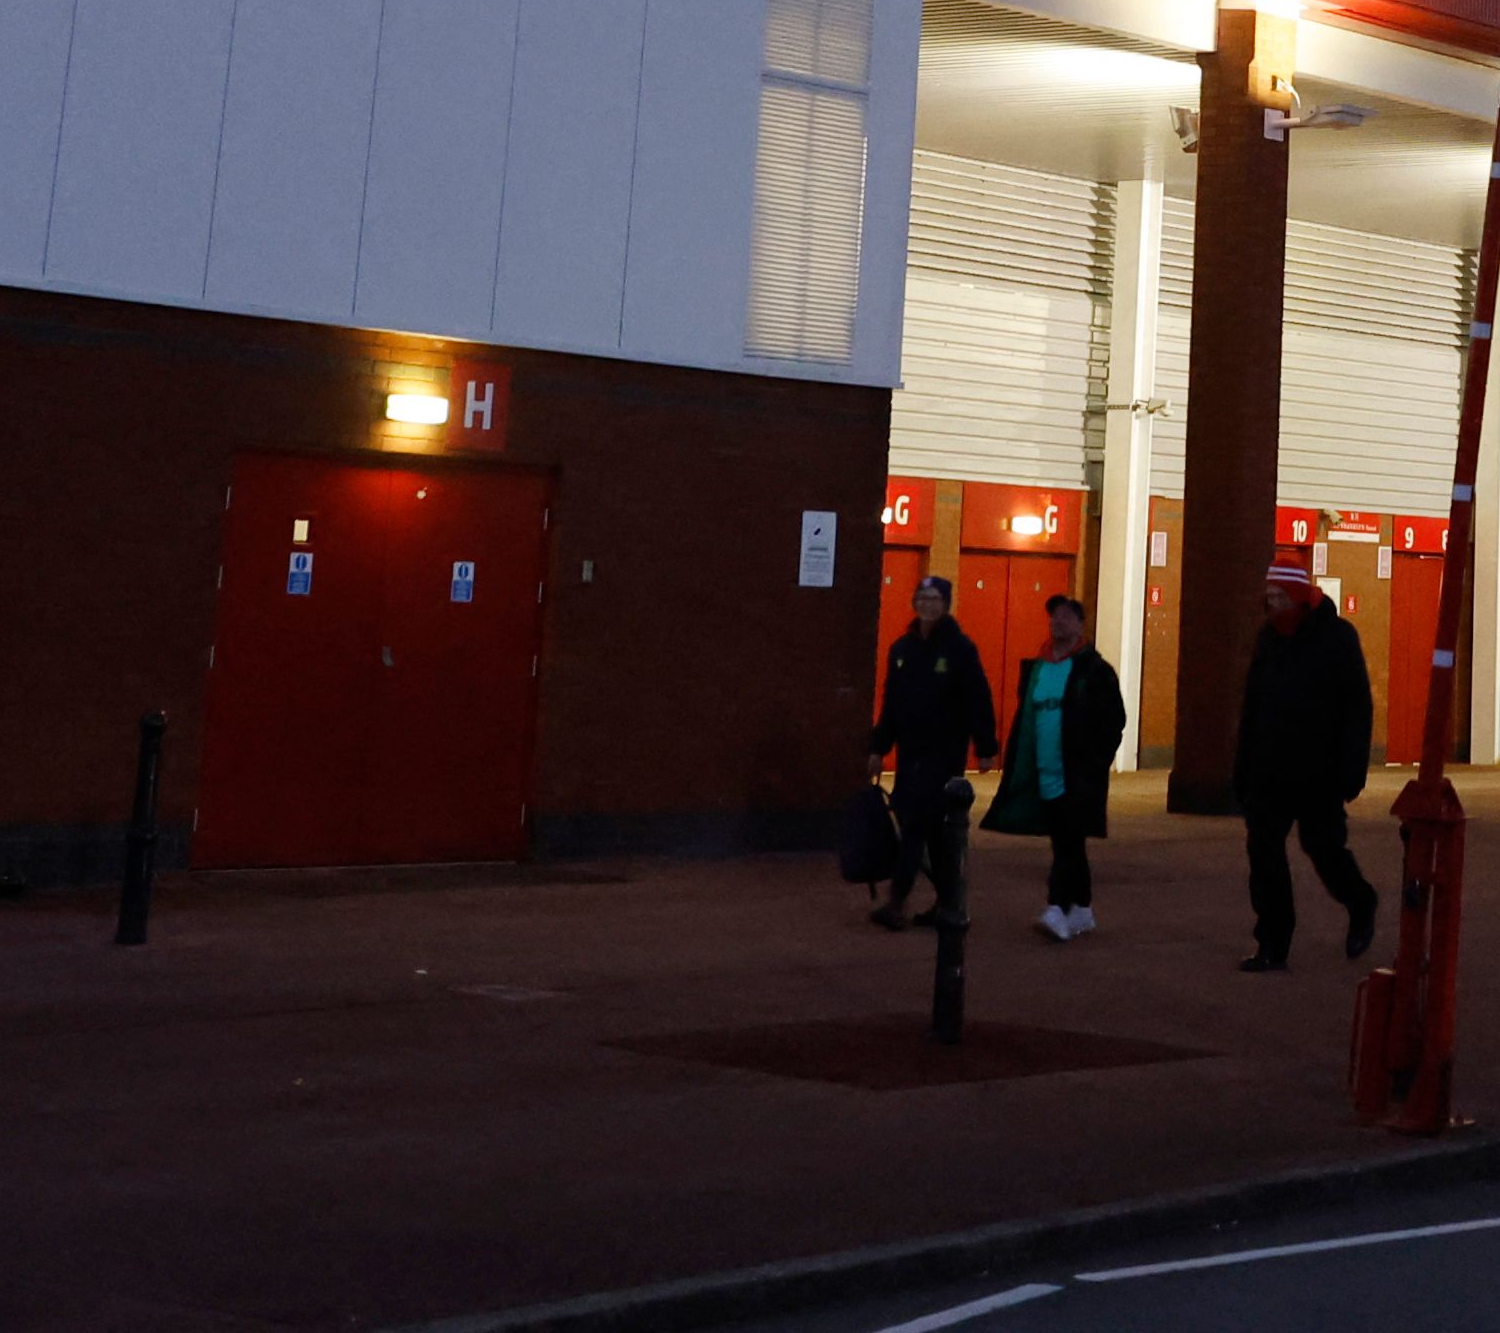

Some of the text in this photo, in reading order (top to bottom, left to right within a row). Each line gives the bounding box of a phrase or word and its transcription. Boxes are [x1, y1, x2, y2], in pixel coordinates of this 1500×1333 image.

[463, 379, 494, 430] H
[894, 495, 910, 525] G
[1044, 505, 1058, 534] G
[1291, 519, 1307, 543] 10
[1404, 526, 1414, 549] 9
